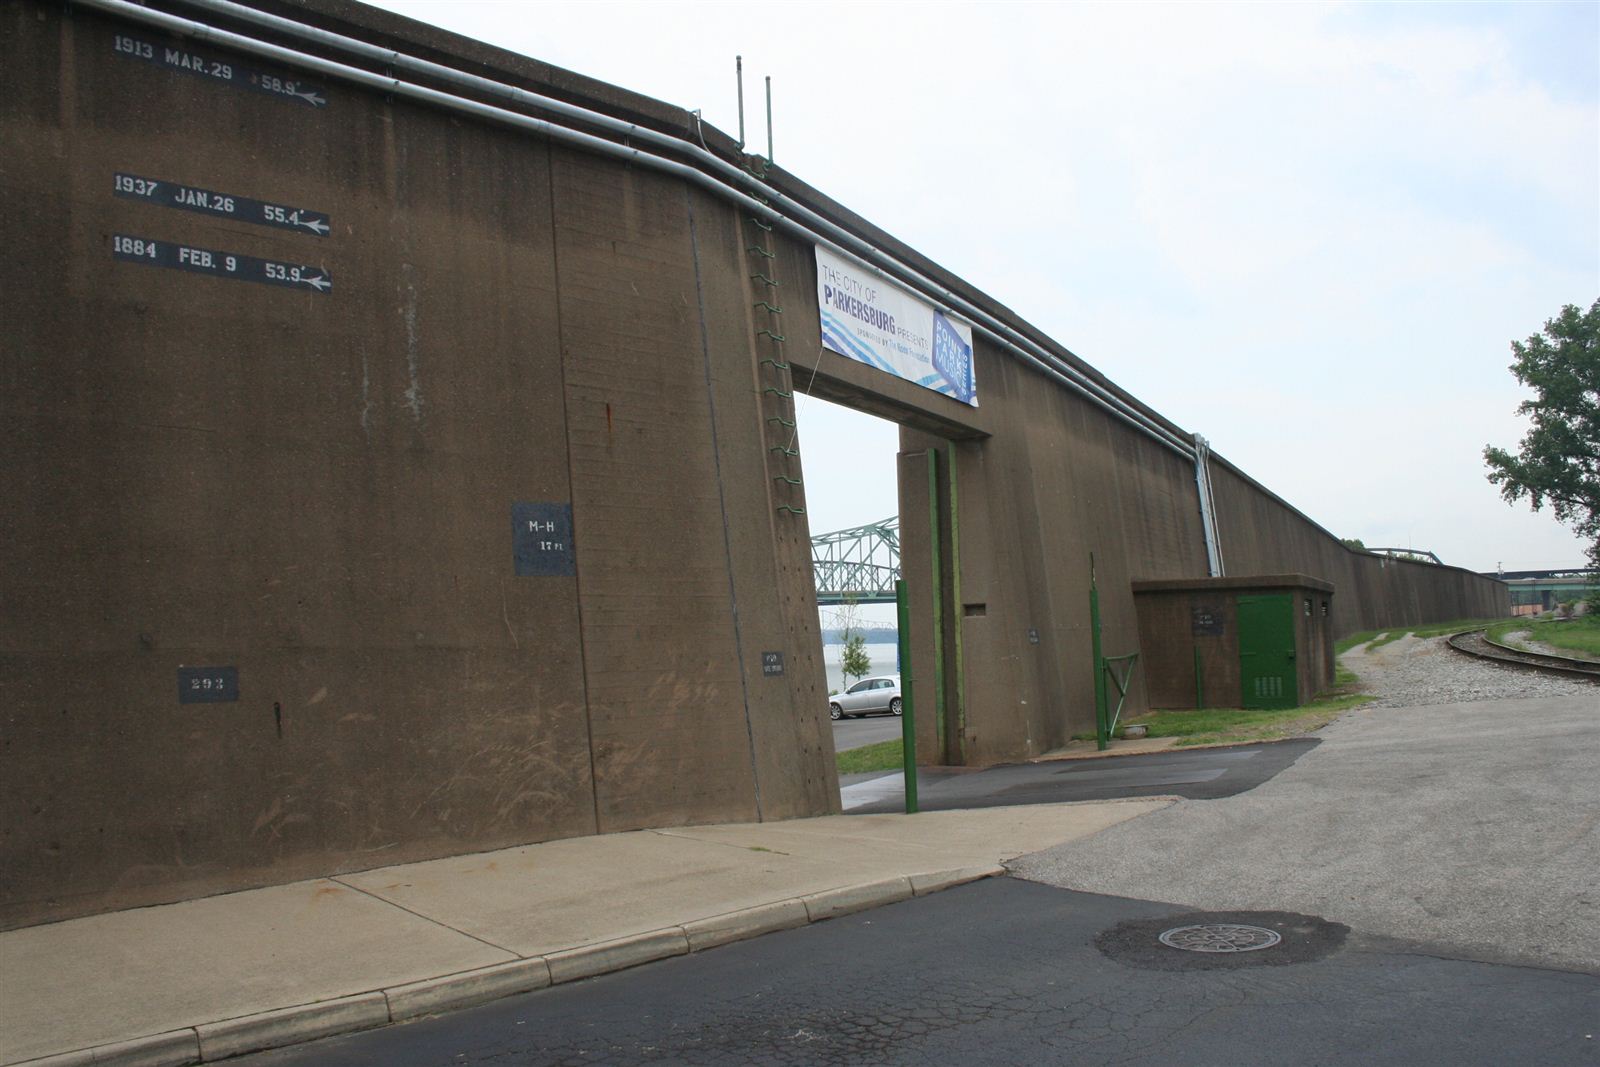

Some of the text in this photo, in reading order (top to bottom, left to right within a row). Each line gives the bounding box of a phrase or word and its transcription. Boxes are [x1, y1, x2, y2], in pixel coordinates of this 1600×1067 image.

[114, 35, 153, 59] 1913
[115, 175, 157, 196] 1937
[114, 236, 156, 259] 1884
[179, 247, 216, 269] FEB.
[225, 256, 237, 272] 9
[822, 264, 877, 304] THE CITY OF
[823, 284, 896, 335] PARKERSBURG
[540, 541, 552, 551] 17
